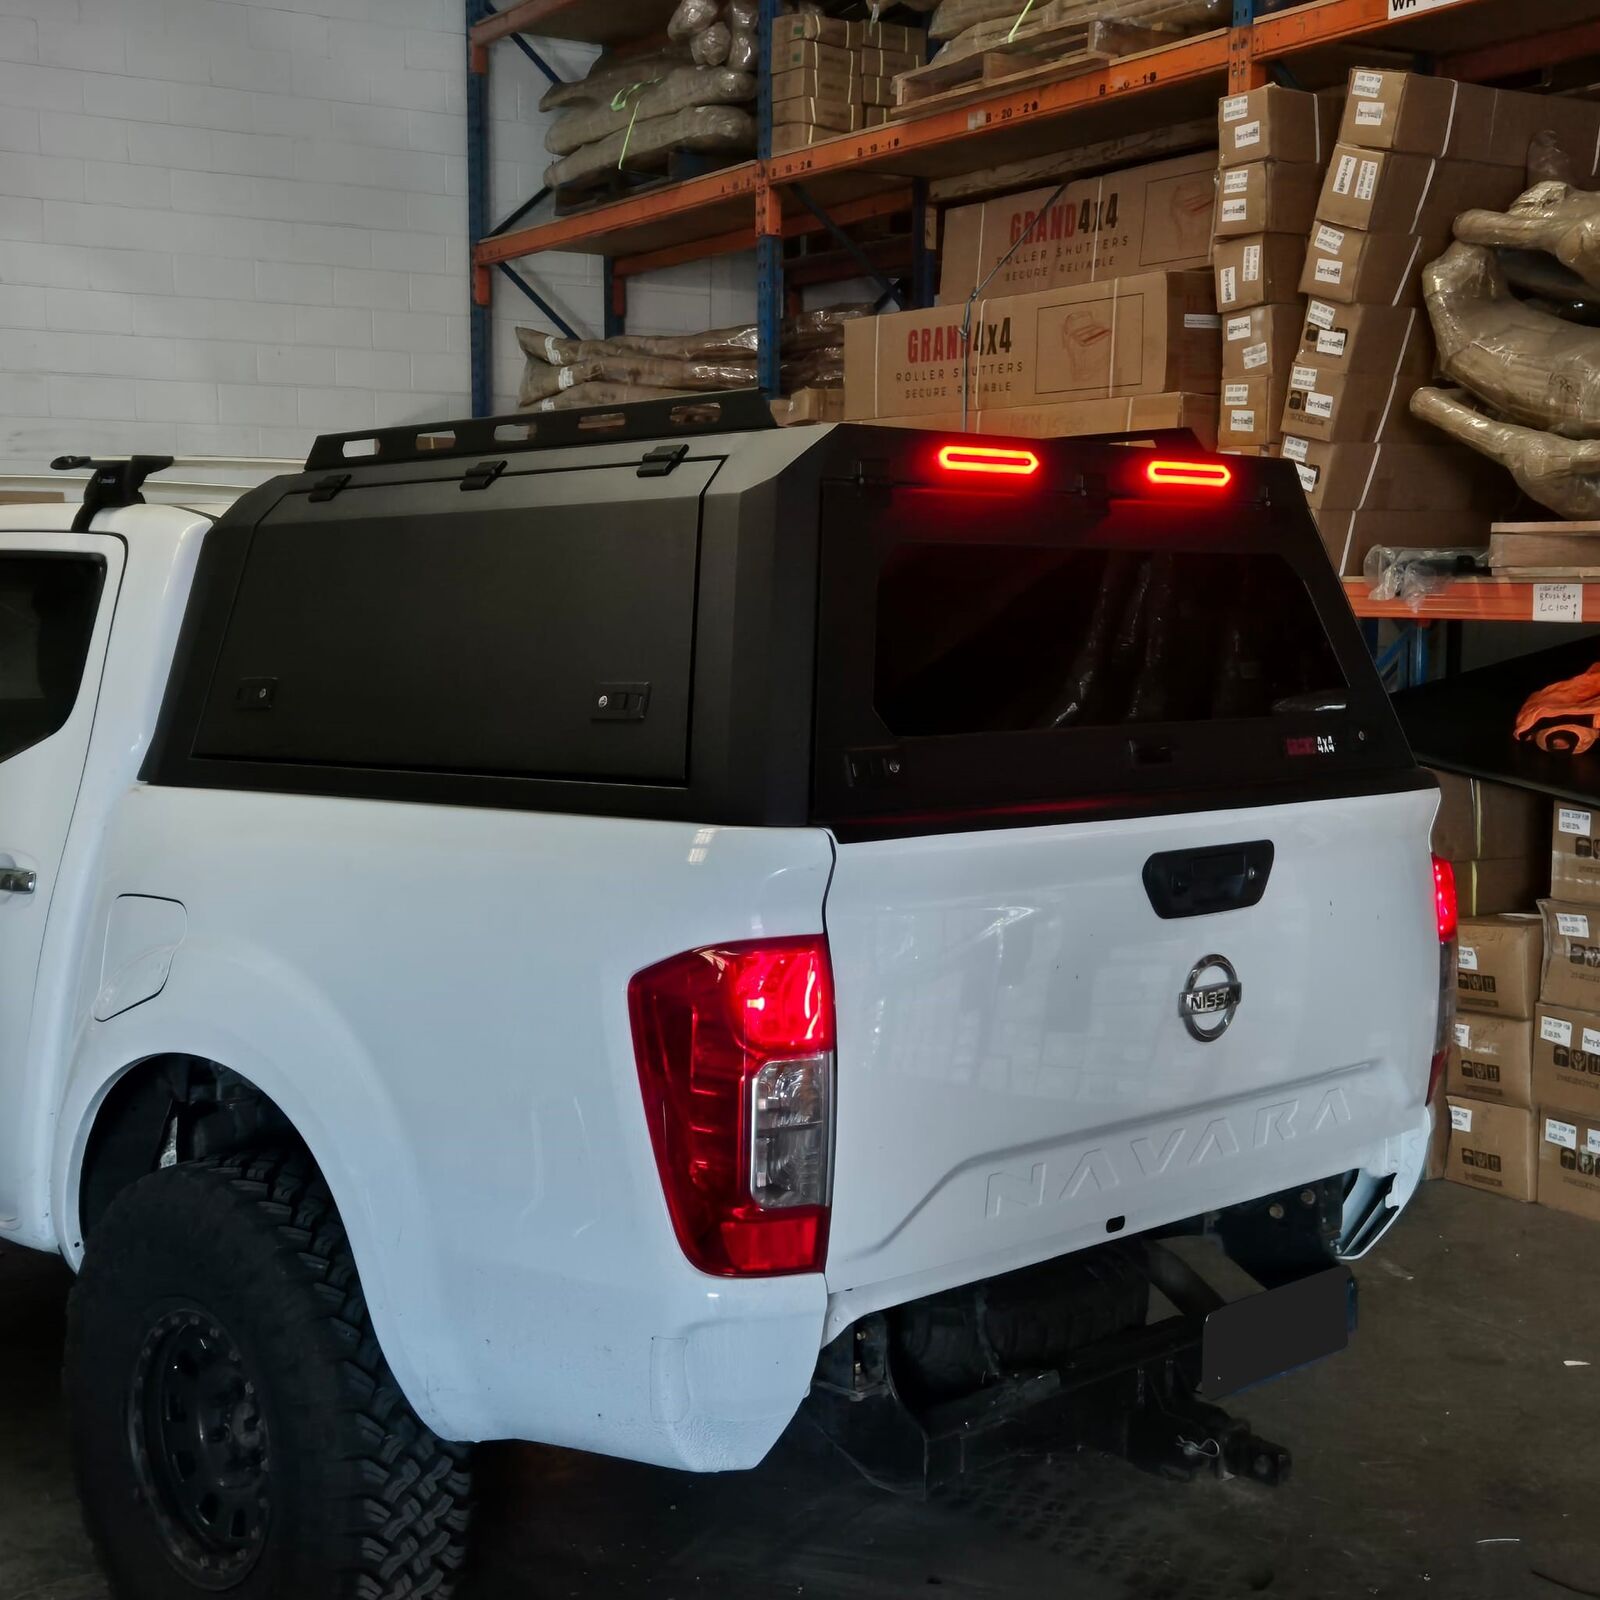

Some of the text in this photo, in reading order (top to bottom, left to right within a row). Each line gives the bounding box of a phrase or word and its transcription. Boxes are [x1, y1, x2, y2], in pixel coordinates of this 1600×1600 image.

[896, 368, 945, 384] ROLLER
[905, 381, 1012, 399] SECURE RLABLE
[1190, 987, 1238, 1010] NISSA
[984, 1086, 1353, 1220] NAVARA
